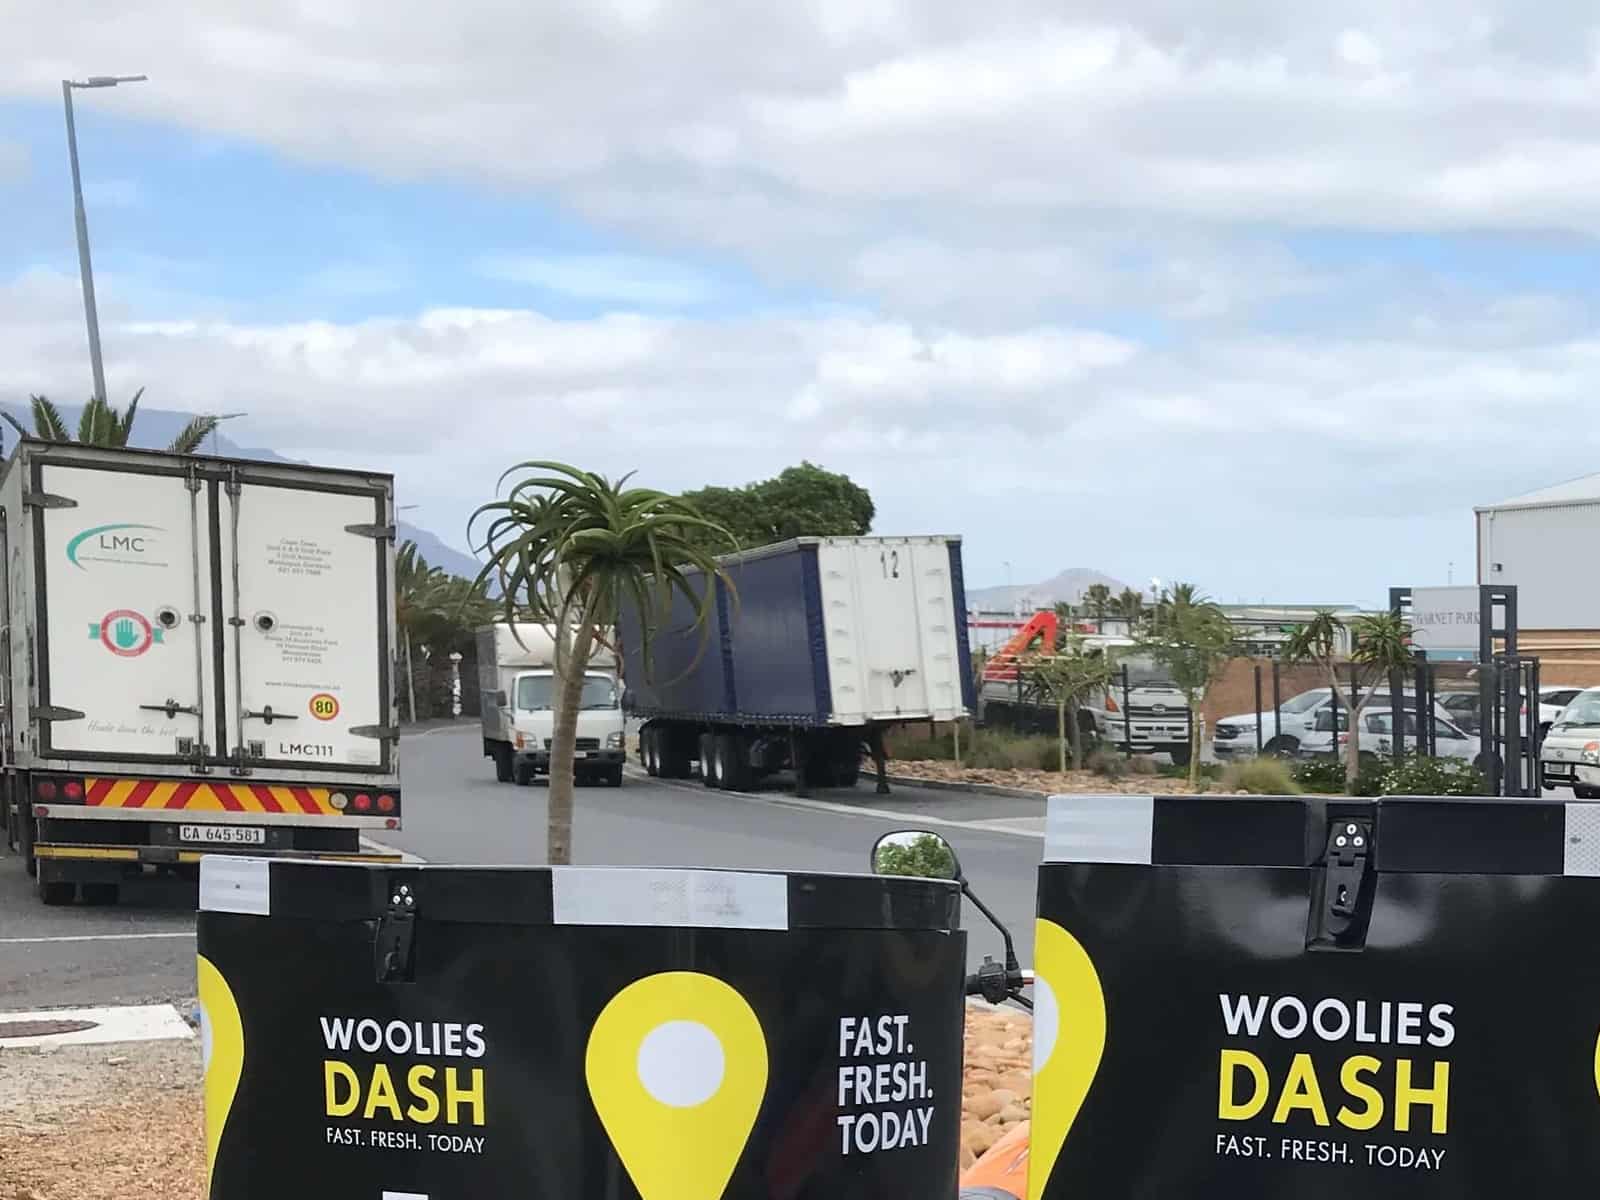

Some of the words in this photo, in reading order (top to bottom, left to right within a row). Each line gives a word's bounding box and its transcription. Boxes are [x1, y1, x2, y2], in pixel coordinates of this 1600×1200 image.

[100, 535, 145, 552] LMC
[880, 550, 899, 579] 12
[315, 701, 333, 714] 80
[280, 743, 333, 757] LMC111
[183, 827, 200, 840] CA
[320, 1017, 486, 1058] WOOLIES
[839, 1015, 913, 1057] FAST.
[1219, 994, 1455, 1047] WOOLIES
[324, 1060, 486, 1126] DASH
[837, 1060, 934, 1107] FRESH.
[1218, 1049, 1450, 1134] DASH
[326, 1127, 366, 1146] FAST.
[370, 1130, 422, 1150] FRESH.
[428, 1134, 486, 1153] TODAY
[837, 1106, 934, 1155] TODAY
[1216, 1134, 1271, 1159] FAST.
[1281, 1139, 1354, 1164] FRESH.
[1364, 1144, 1446, 1170] TODAY
